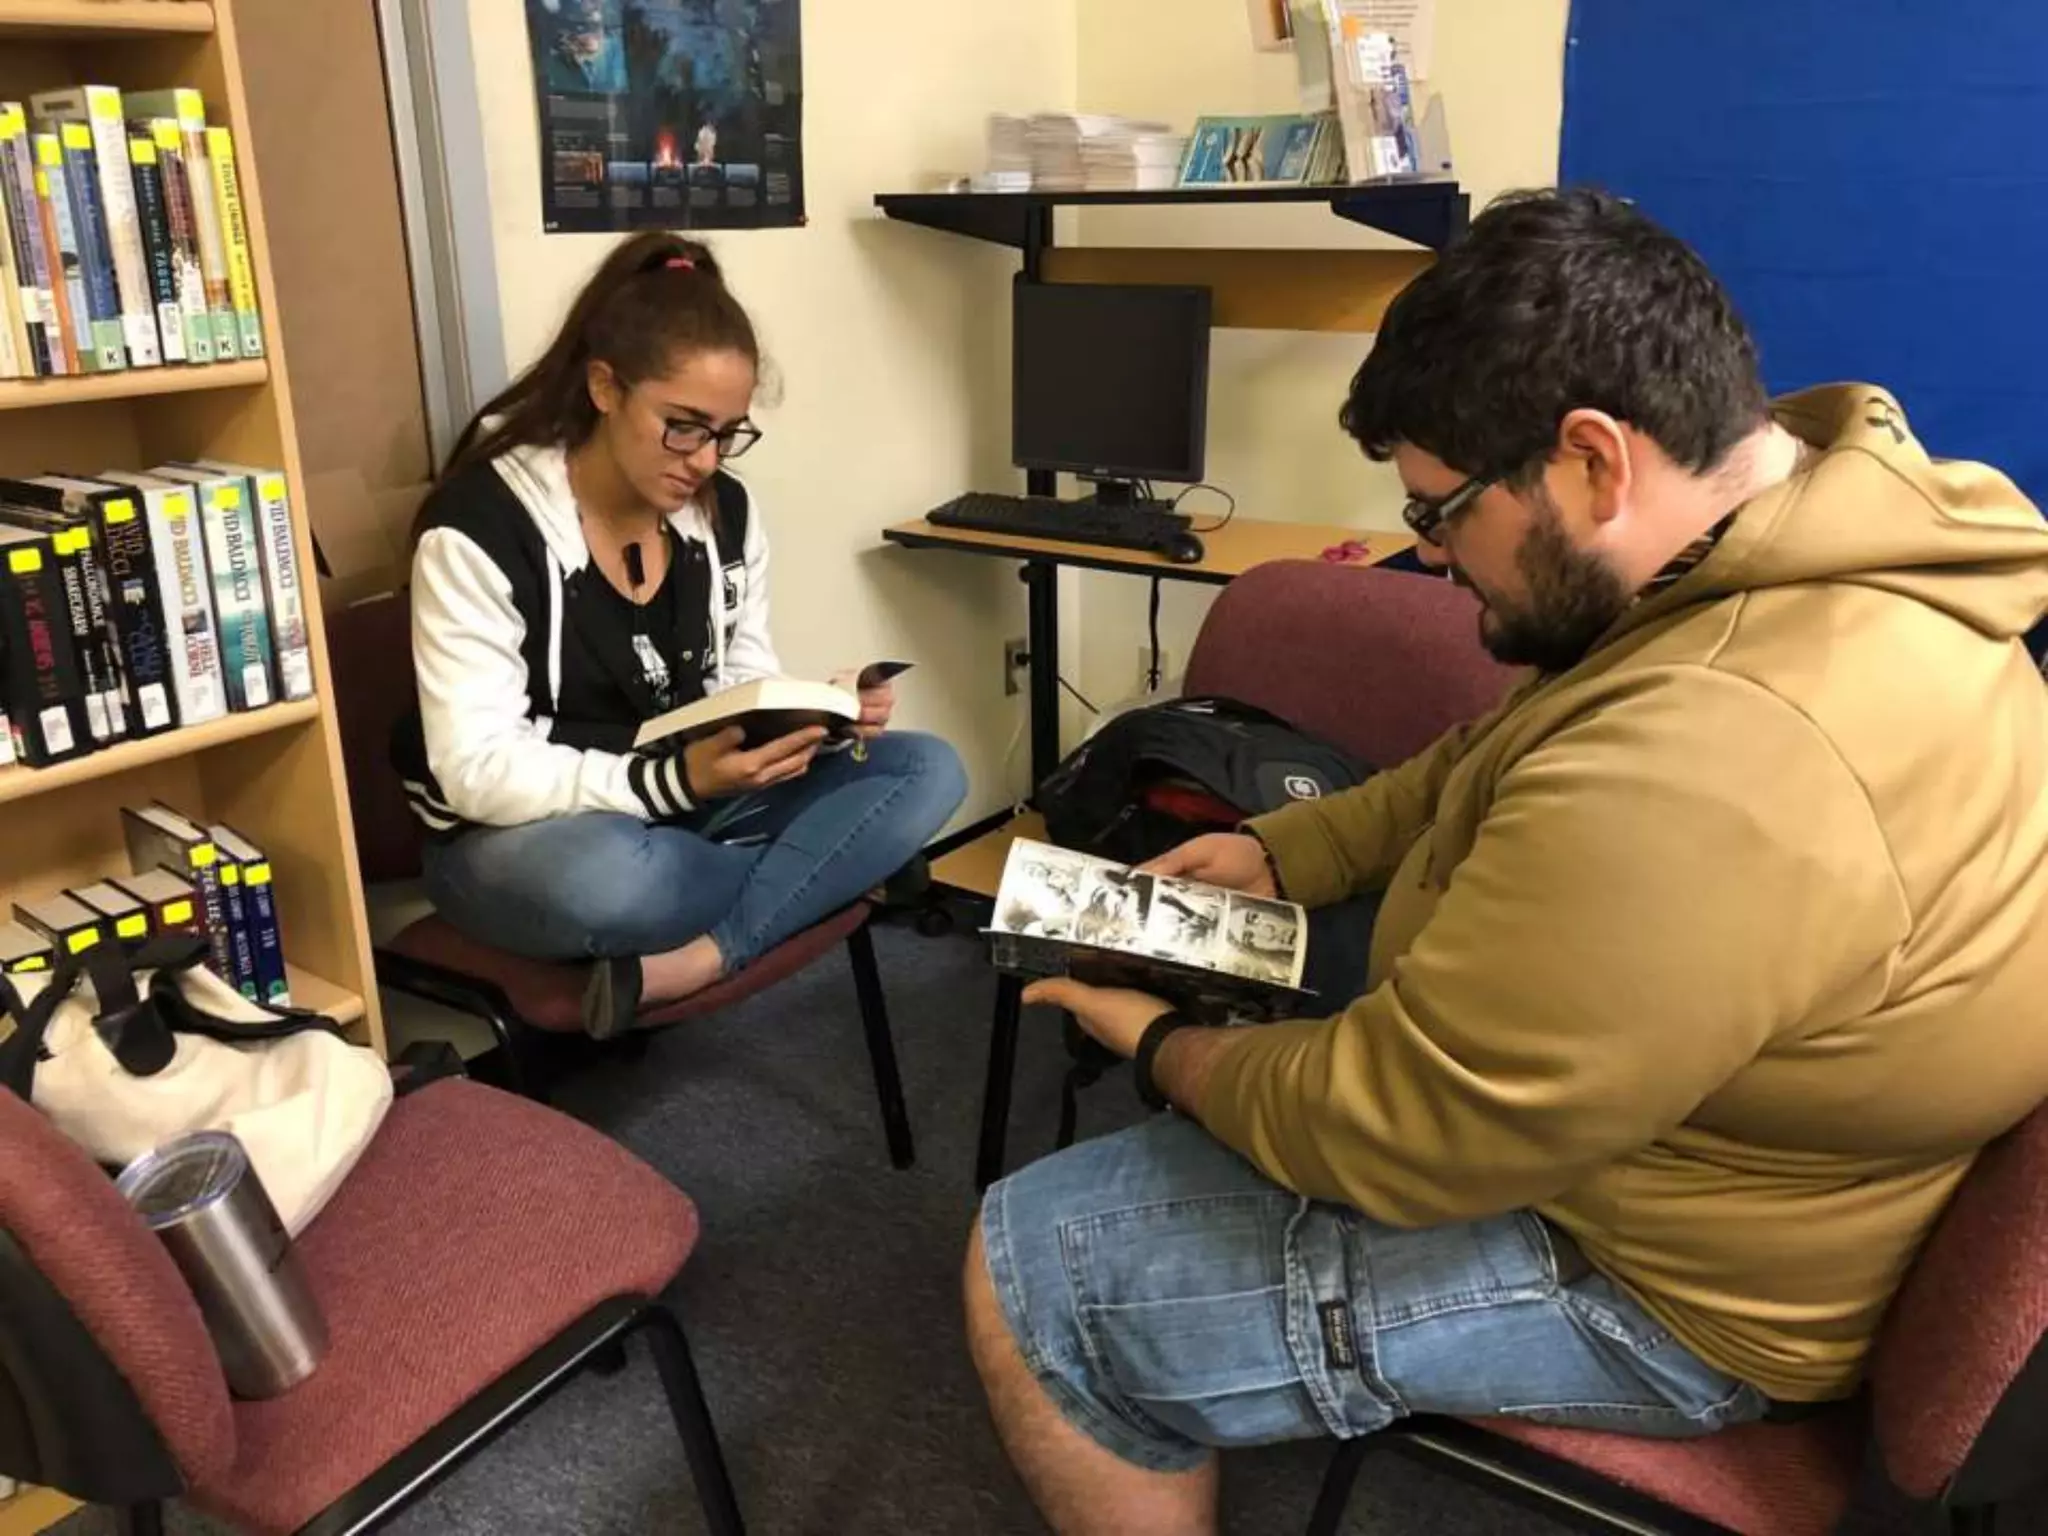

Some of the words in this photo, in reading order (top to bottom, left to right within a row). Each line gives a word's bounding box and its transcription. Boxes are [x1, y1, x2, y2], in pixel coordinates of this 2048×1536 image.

[172, 540, 198, 606] BALDACCI
[226, 534, 251, 603] BALDACCI
[273, 525, 294, 589] BALDACCI
